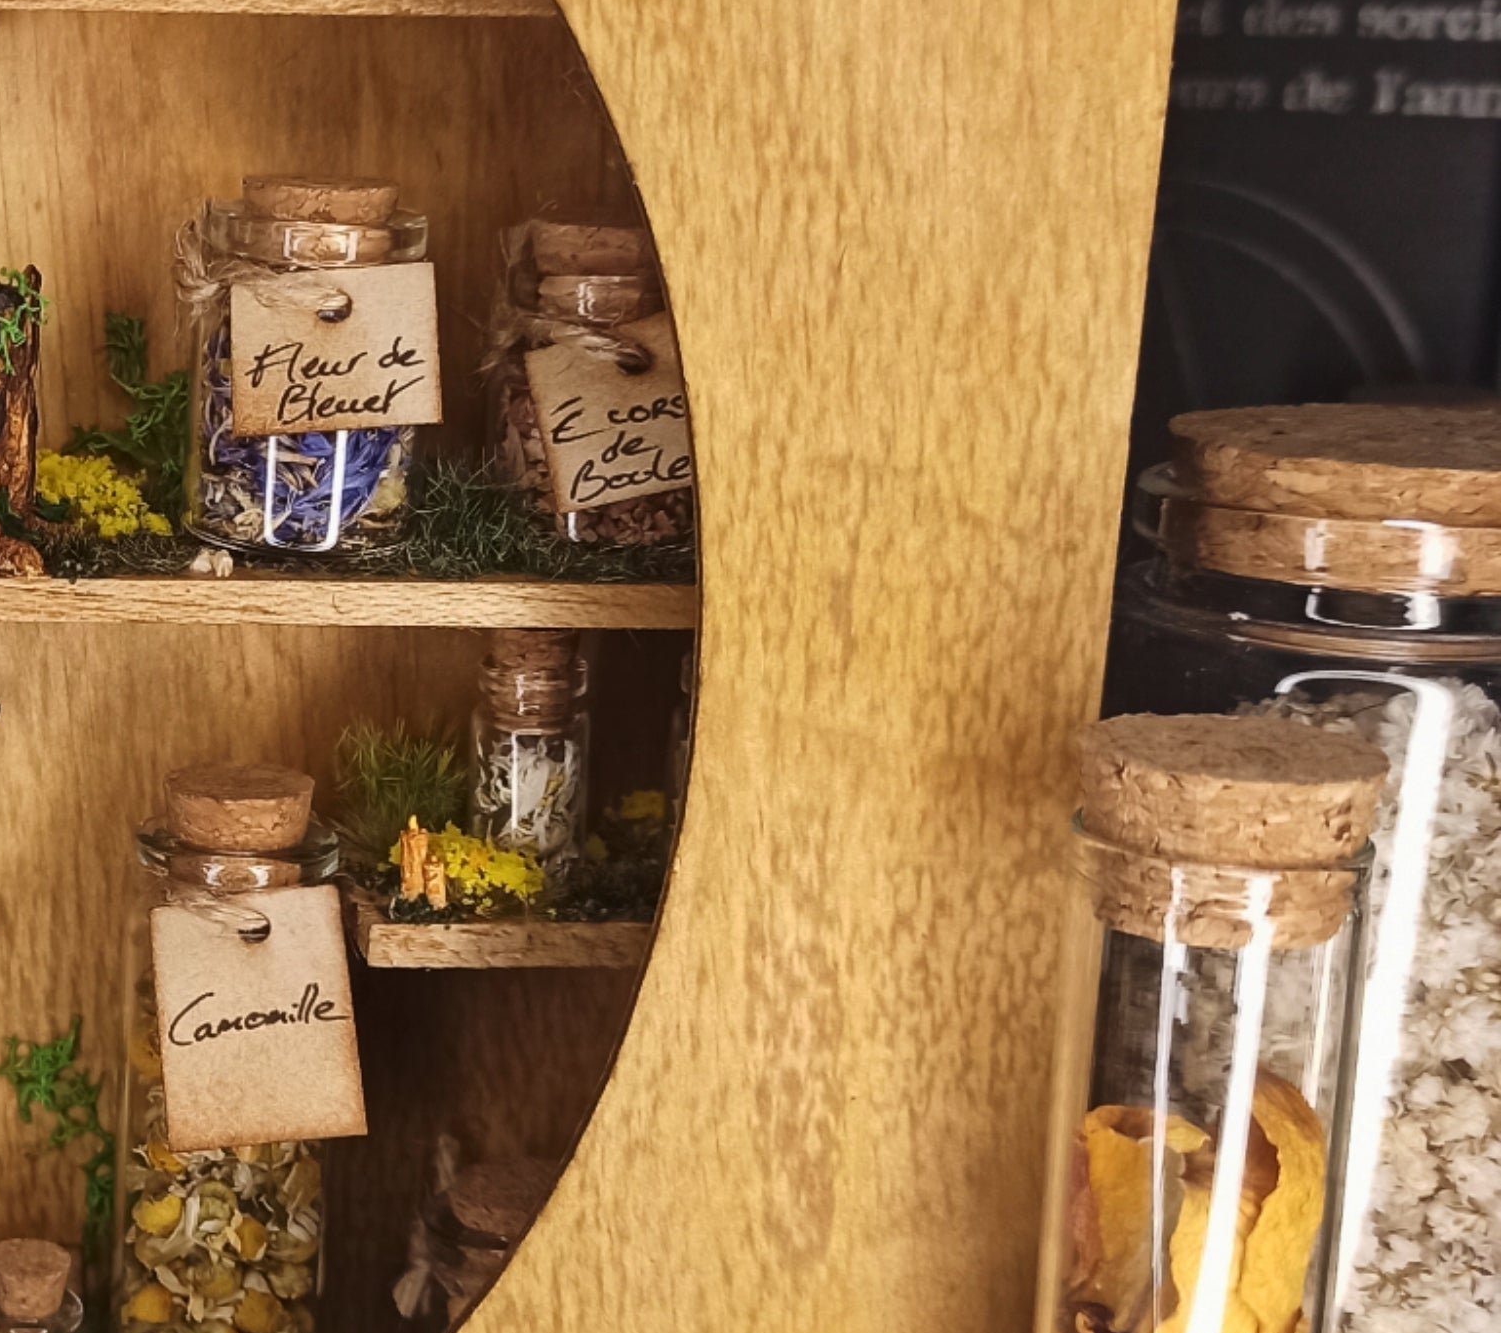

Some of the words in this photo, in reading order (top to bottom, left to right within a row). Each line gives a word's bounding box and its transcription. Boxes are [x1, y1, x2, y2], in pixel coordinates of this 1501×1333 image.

[245, 343, 368, 388] Fleur
[379, 336, 425, 368] de
[276, 375, 426, 425] Bleuet
[601, 431, 659, 464] de
[168, 982, 352, 1046] Camomille
